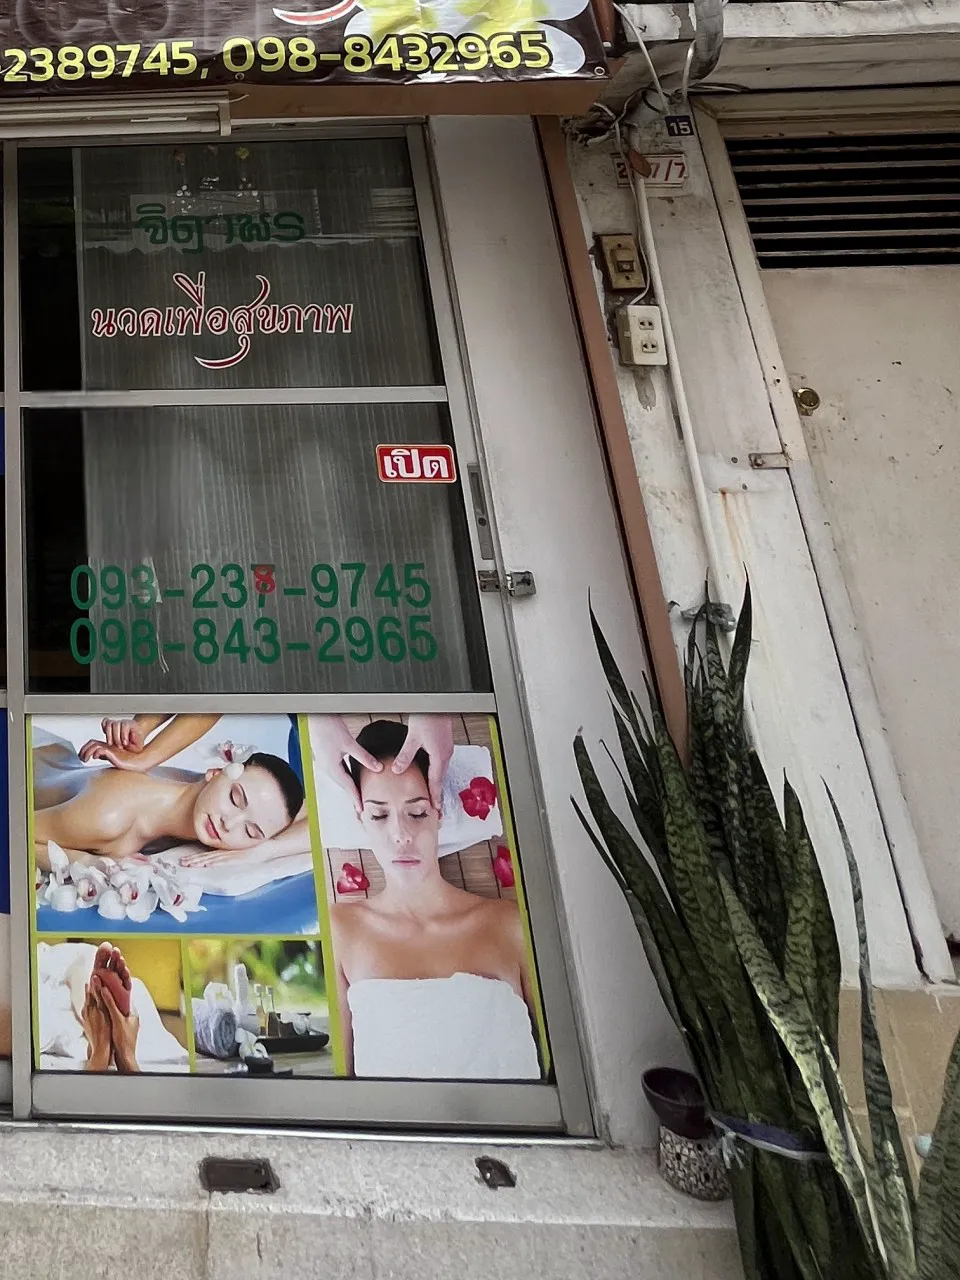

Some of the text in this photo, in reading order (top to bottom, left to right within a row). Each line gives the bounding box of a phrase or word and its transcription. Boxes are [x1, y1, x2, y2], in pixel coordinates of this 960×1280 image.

[222, 31, 551, 77] 098-8432965
[669, 121, 691, 134] 15
[616, 159, 686, 182] 27/7
[90, 271, 355, 370] นวดเพื่อสุขภาพ
[383, 448, 450, 479] เปิด
[69, 614, 438, 666] 098-843-2965
